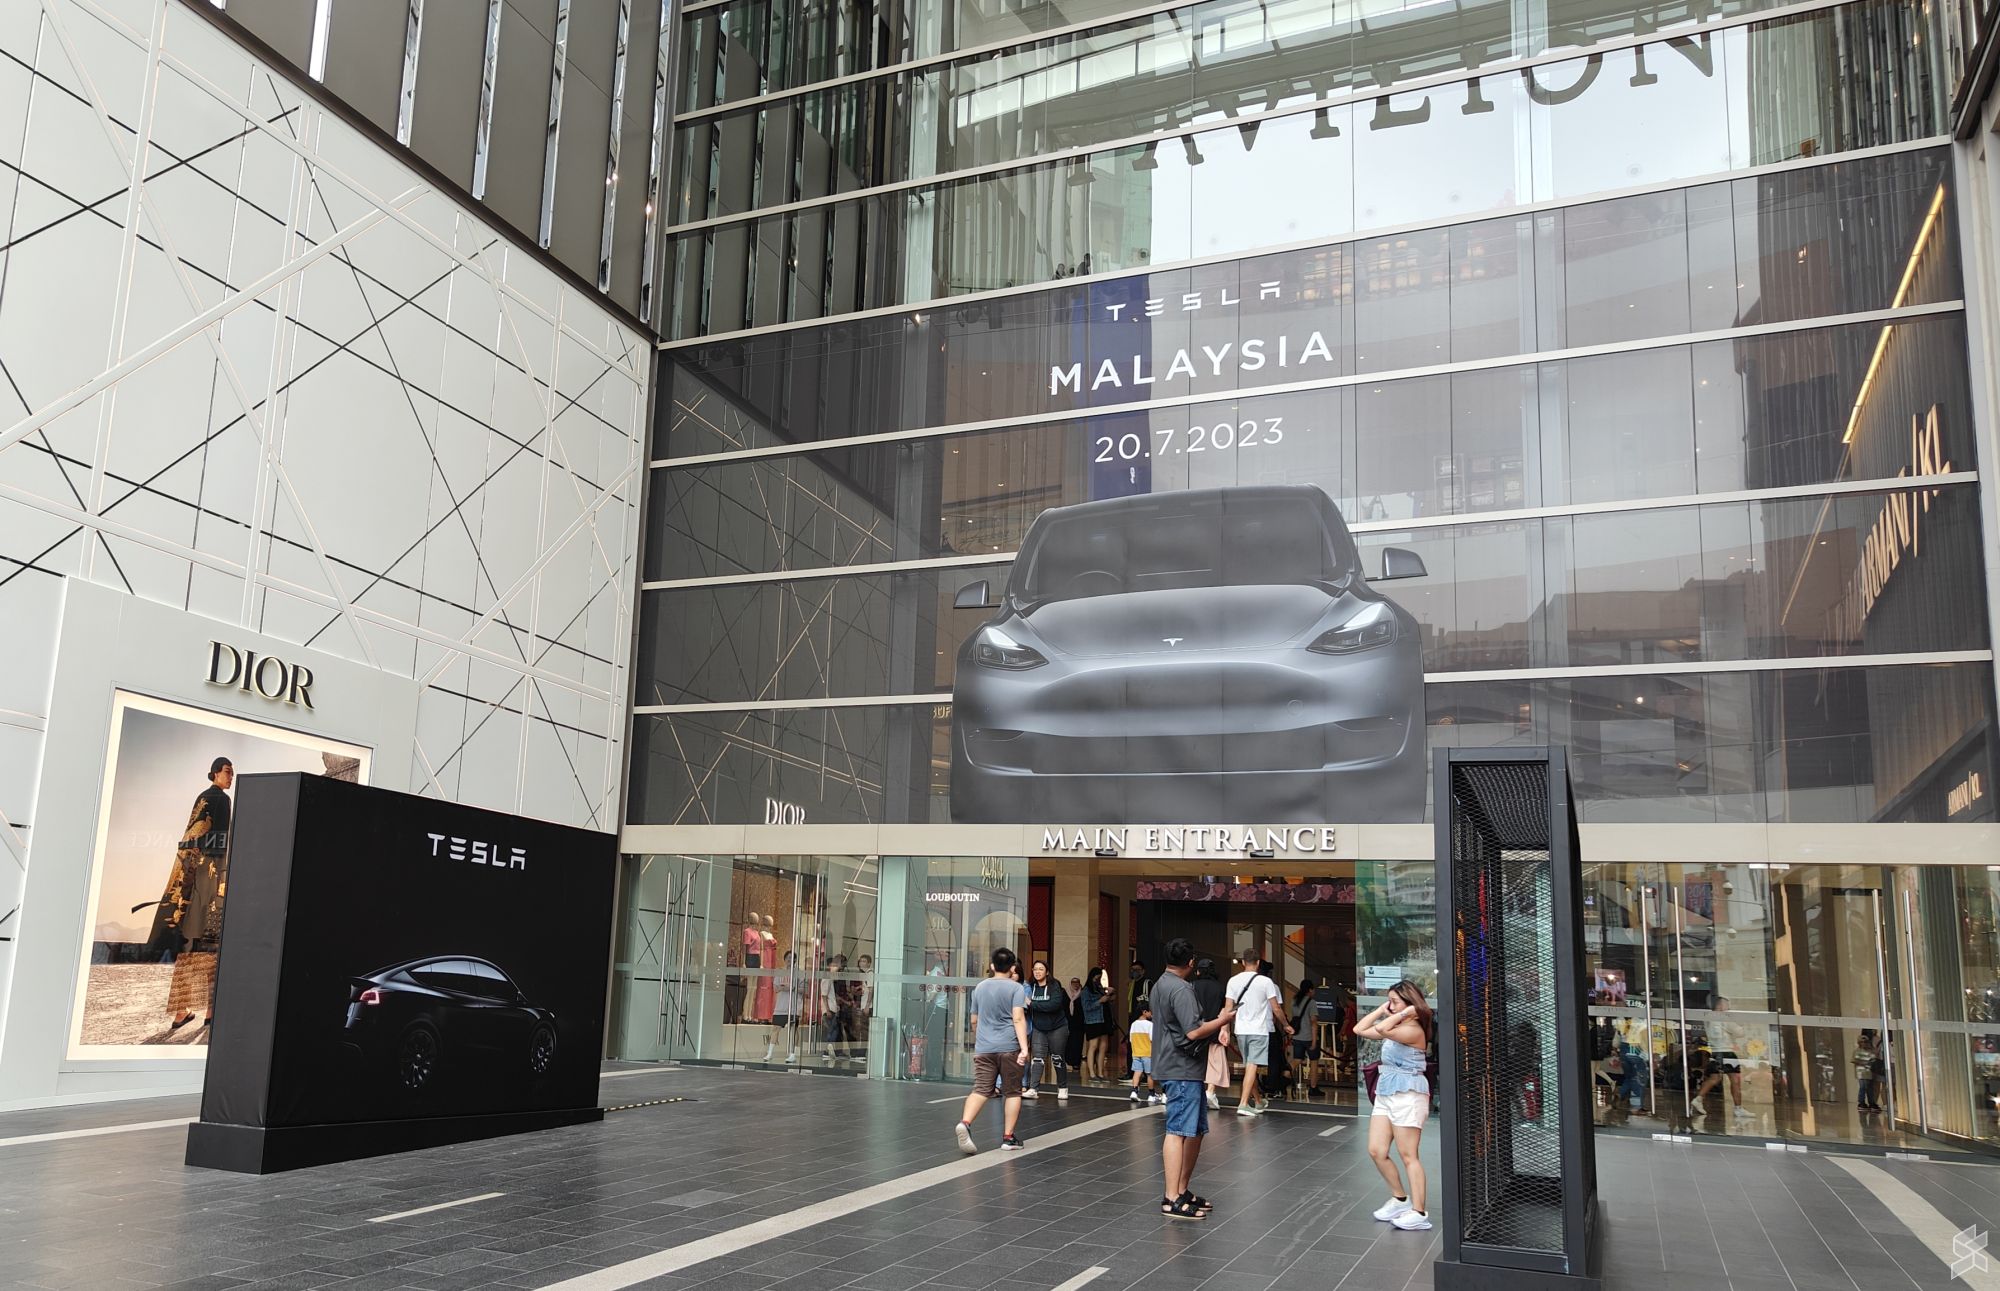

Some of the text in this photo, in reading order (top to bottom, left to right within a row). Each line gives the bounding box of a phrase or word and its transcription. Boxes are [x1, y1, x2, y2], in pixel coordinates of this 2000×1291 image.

[1067, 0, 1716, 186] AVILION
[1105, 280, 1281, 322] TESLA
[1051, 331, 1334, 396] MALAYSIA
[1094, 417, 1284, 463] 20.7.2023
[204, 640, 315, 710] DIOR
[765, 797, 806, 824] DIOR
[427, 832, 527, 871] TESLA
[1042, 826, 1337, 852] MAIN ENTRANCE
[926, 893, 980, 902] LOUBOUTIN
